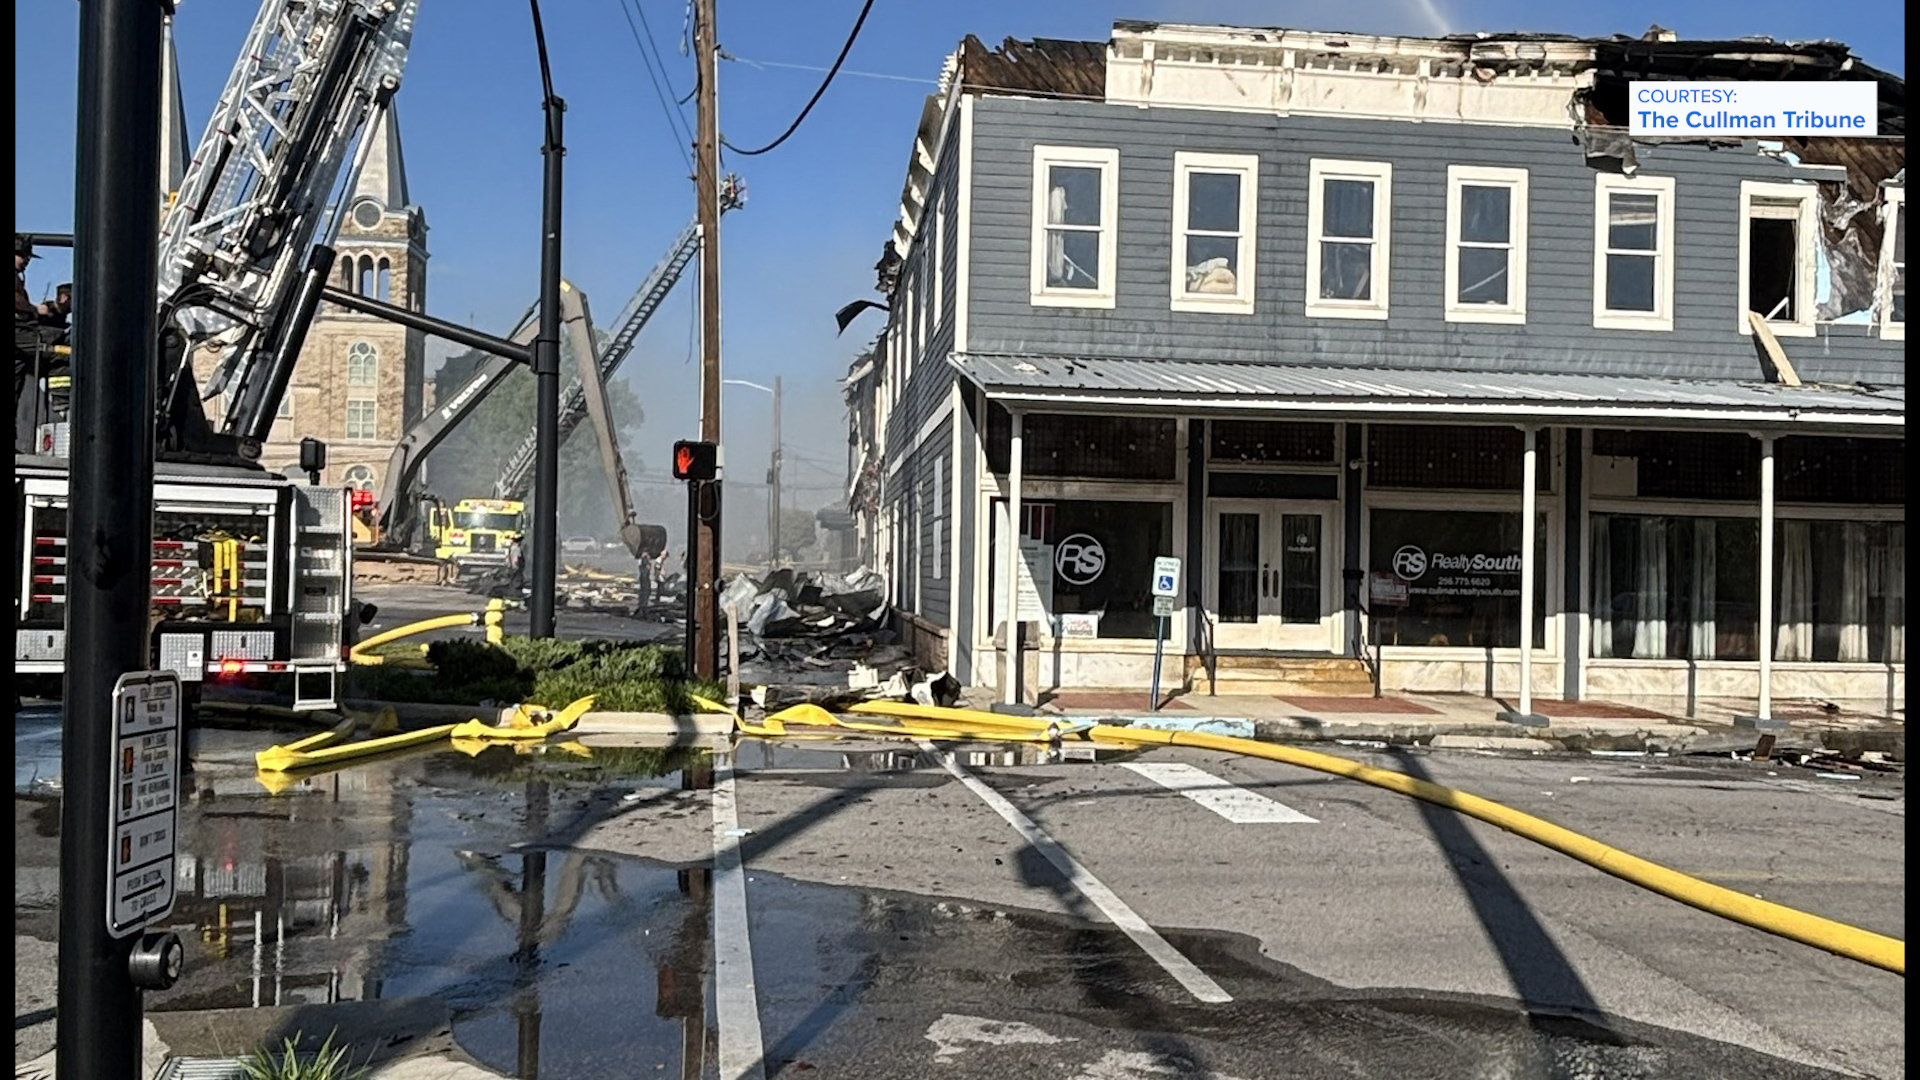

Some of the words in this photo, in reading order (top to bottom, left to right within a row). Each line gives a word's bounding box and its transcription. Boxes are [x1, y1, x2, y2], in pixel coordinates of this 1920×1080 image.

[449, 379, 481, 410] VOLVO
[1059, 544, 1103, 574] RS
[1431, 552, 1522, 573] RealtySouth
